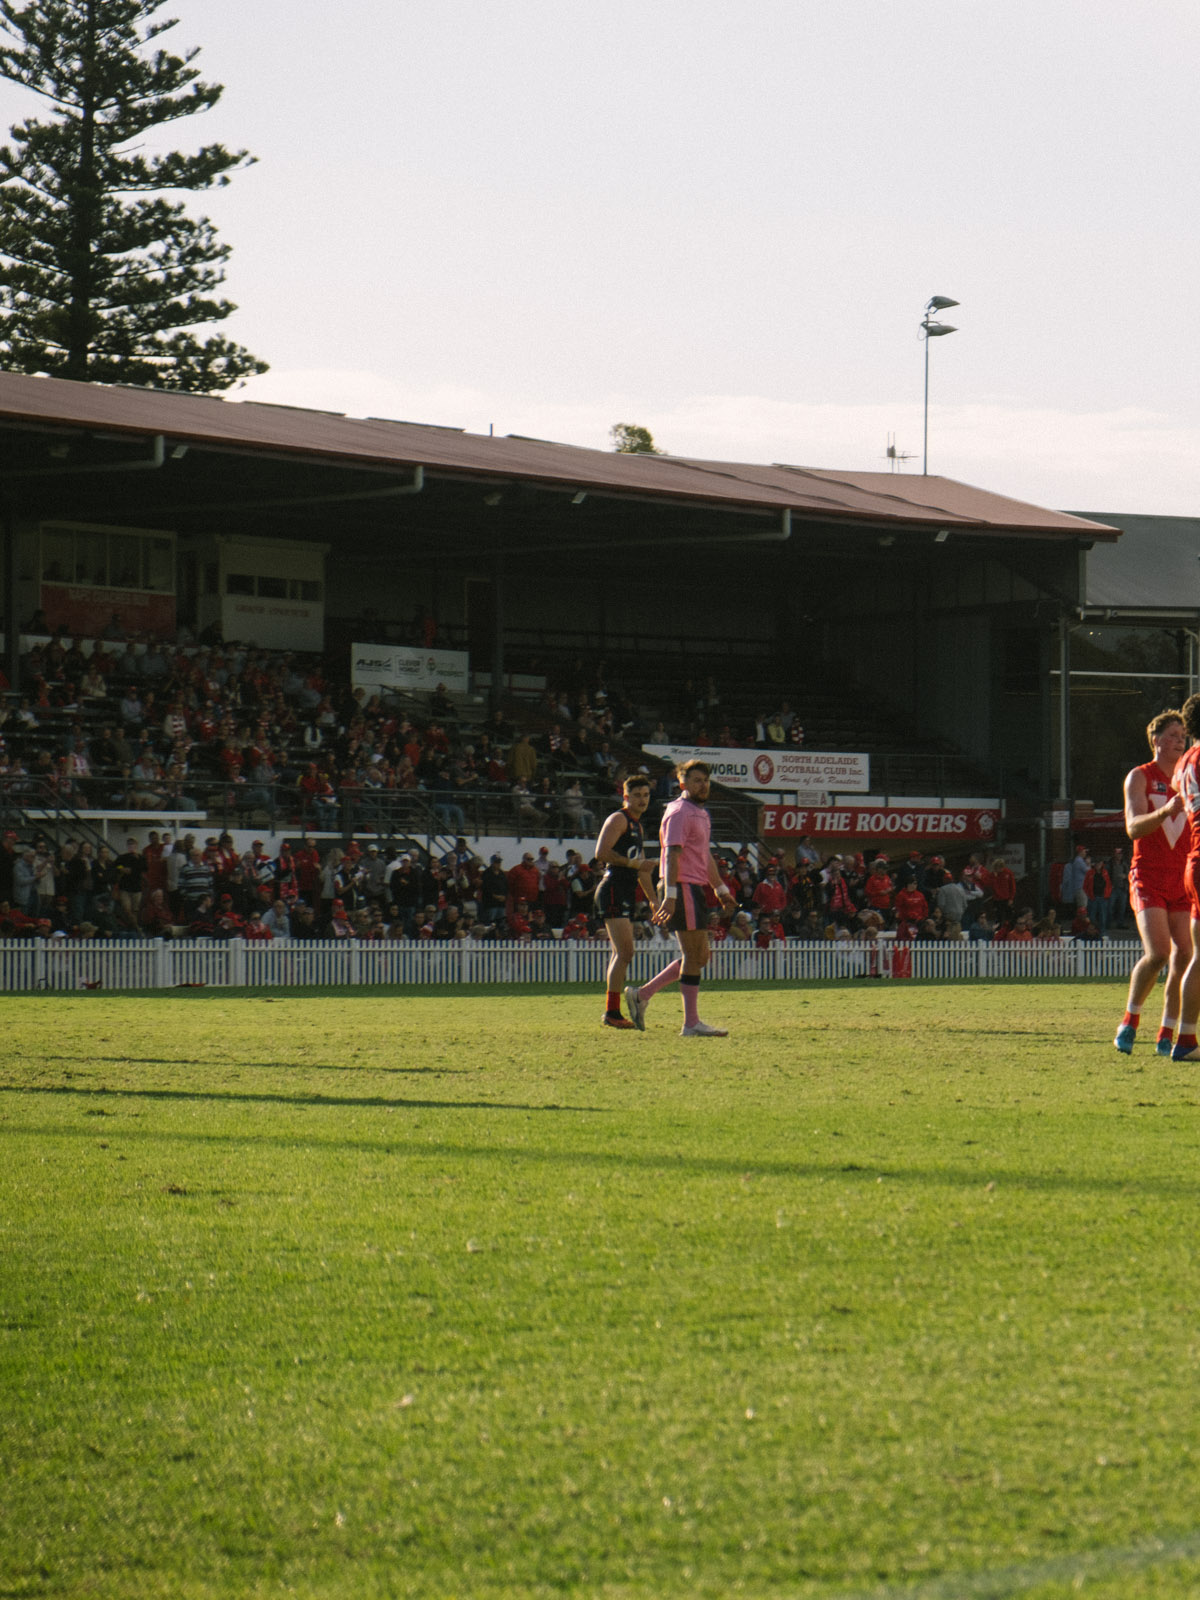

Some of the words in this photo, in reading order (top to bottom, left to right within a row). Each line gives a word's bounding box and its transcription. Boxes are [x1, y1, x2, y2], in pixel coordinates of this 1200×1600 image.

[782, 755, 812, 763] NORTH
[813, 756, 859, 765] ADELAIDE
[777, 765, 821, 774] FOOTBALL
[823, 767, 847, 775] CLUB
[779, 774, 801, 783] Home
[803, 776, 812, 785] of
[813, 776, 824, 784] the
[827, 776, 861, 785] Roosters
[819, 791, 828, 806] A
[780, 811, 808, 831] OF
[812, 812, 852, 832] THE
[855, 813, 968, 833] ROOSTERS
